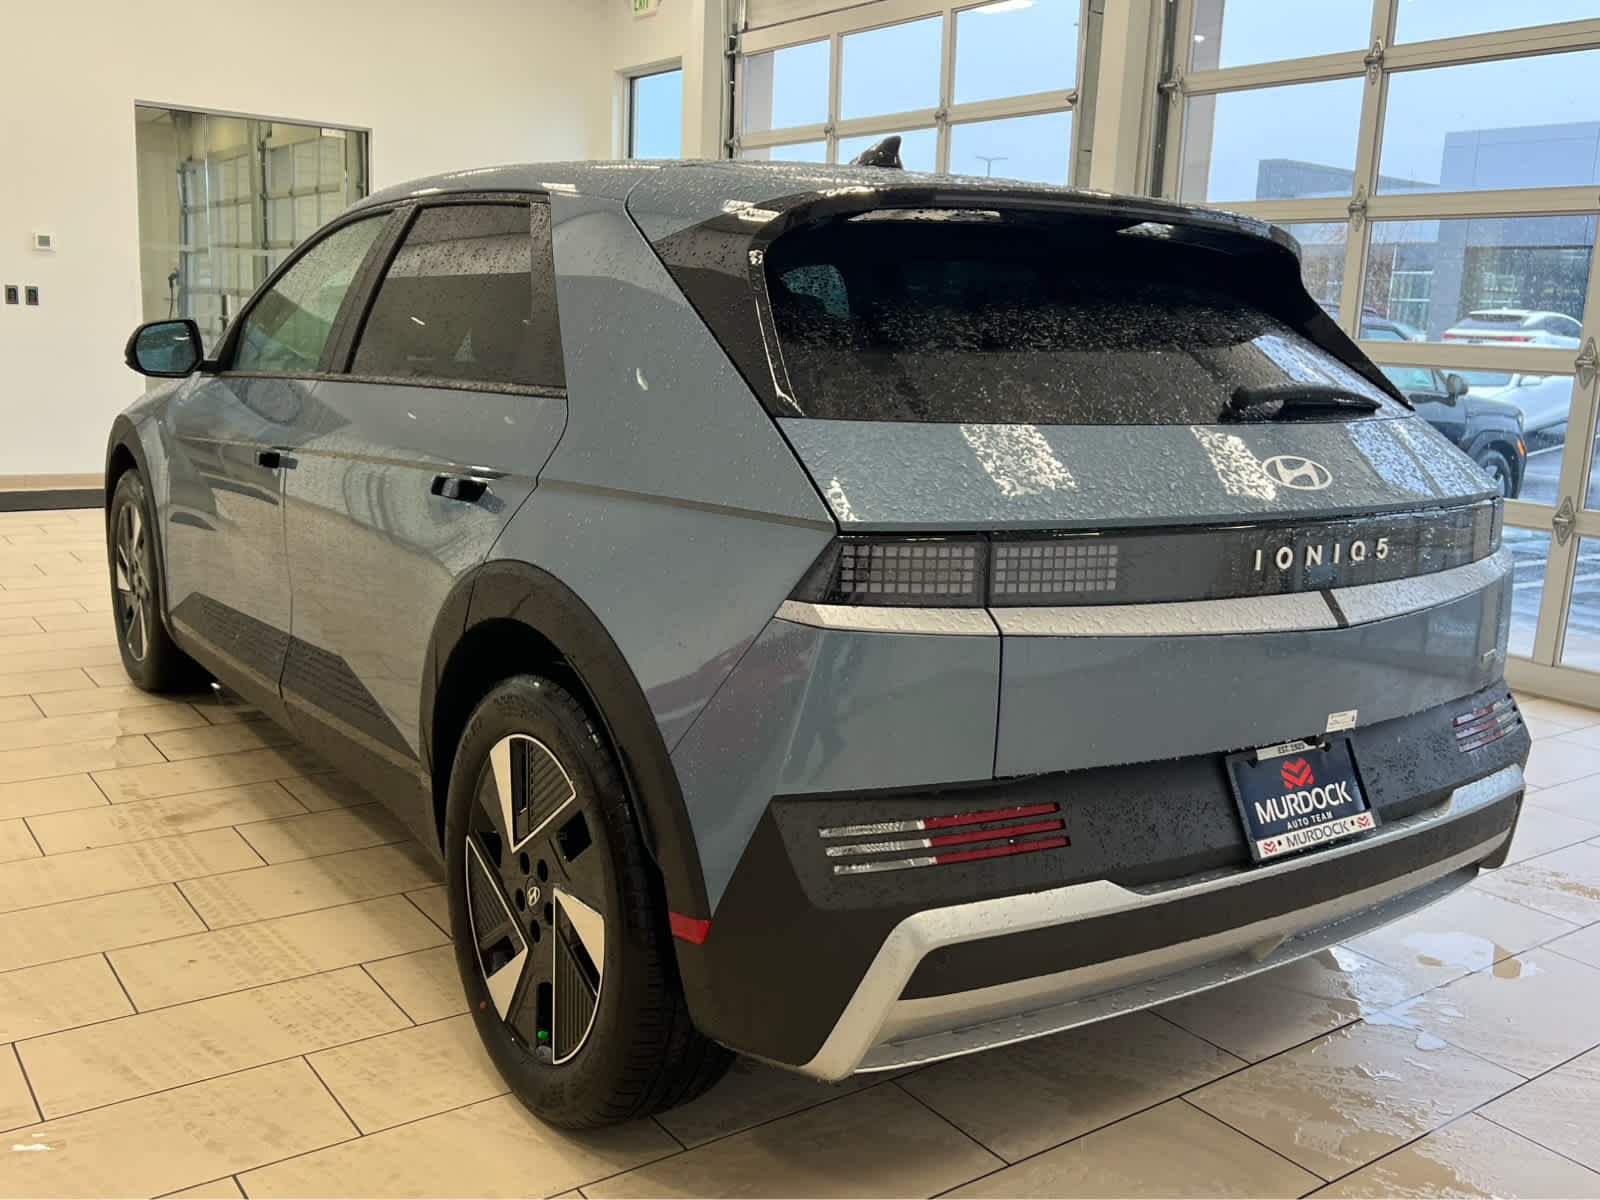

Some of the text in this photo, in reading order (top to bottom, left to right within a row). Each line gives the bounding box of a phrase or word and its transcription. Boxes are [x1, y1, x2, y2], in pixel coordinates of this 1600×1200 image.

[1254, 781, 1352, 824] MURDOCK
[1285, 821, 1350, 848] MURDOCK
[1287, 811, 1334, 831] AUTO TEAM
